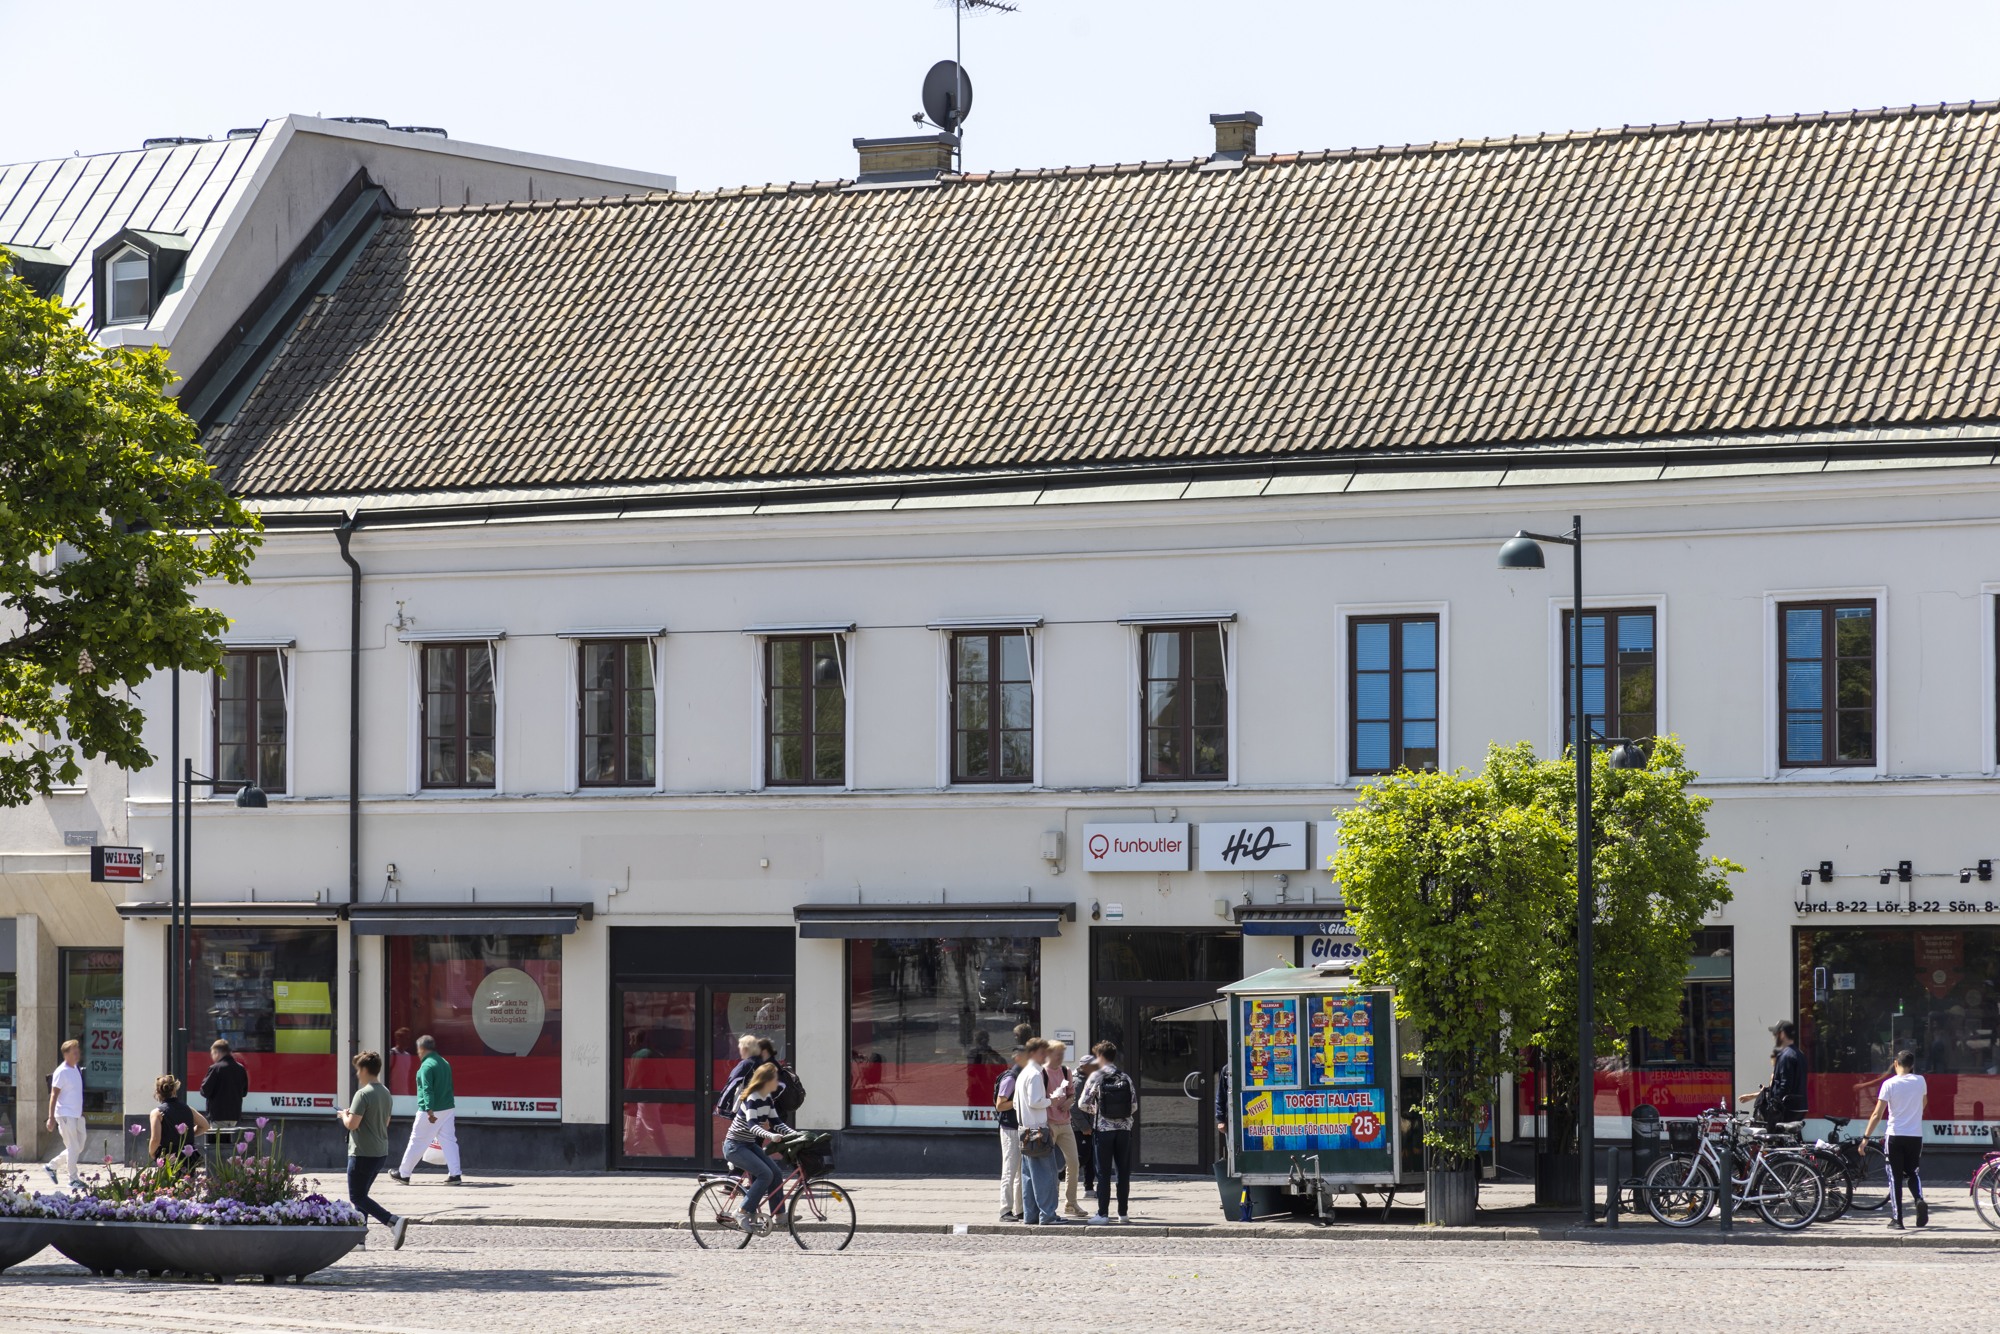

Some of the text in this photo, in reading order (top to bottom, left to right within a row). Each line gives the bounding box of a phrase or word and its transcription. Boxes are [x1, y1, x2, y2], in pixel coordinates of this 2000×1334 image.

[1114, 837, 1182, 853] funbutler
[1794, 901, 1831, 913] Vard.
[1836, 901, 1868, 913] 8-22
[1876, 901, 1904, 913] Lör.
[1908, 901, 1940, 913] 8-22
[1949, 901, 1980, 913] Sön.
[91, 1030, 123, 1050] 25%
[1247, 1098, 1270, 1117] NYHET
[1285, 1093, 1374, 1108] TORGET FALAFEL
[1248, 1122, 1348, 1137] FALAFEL RULLE FÖR ENDAST
